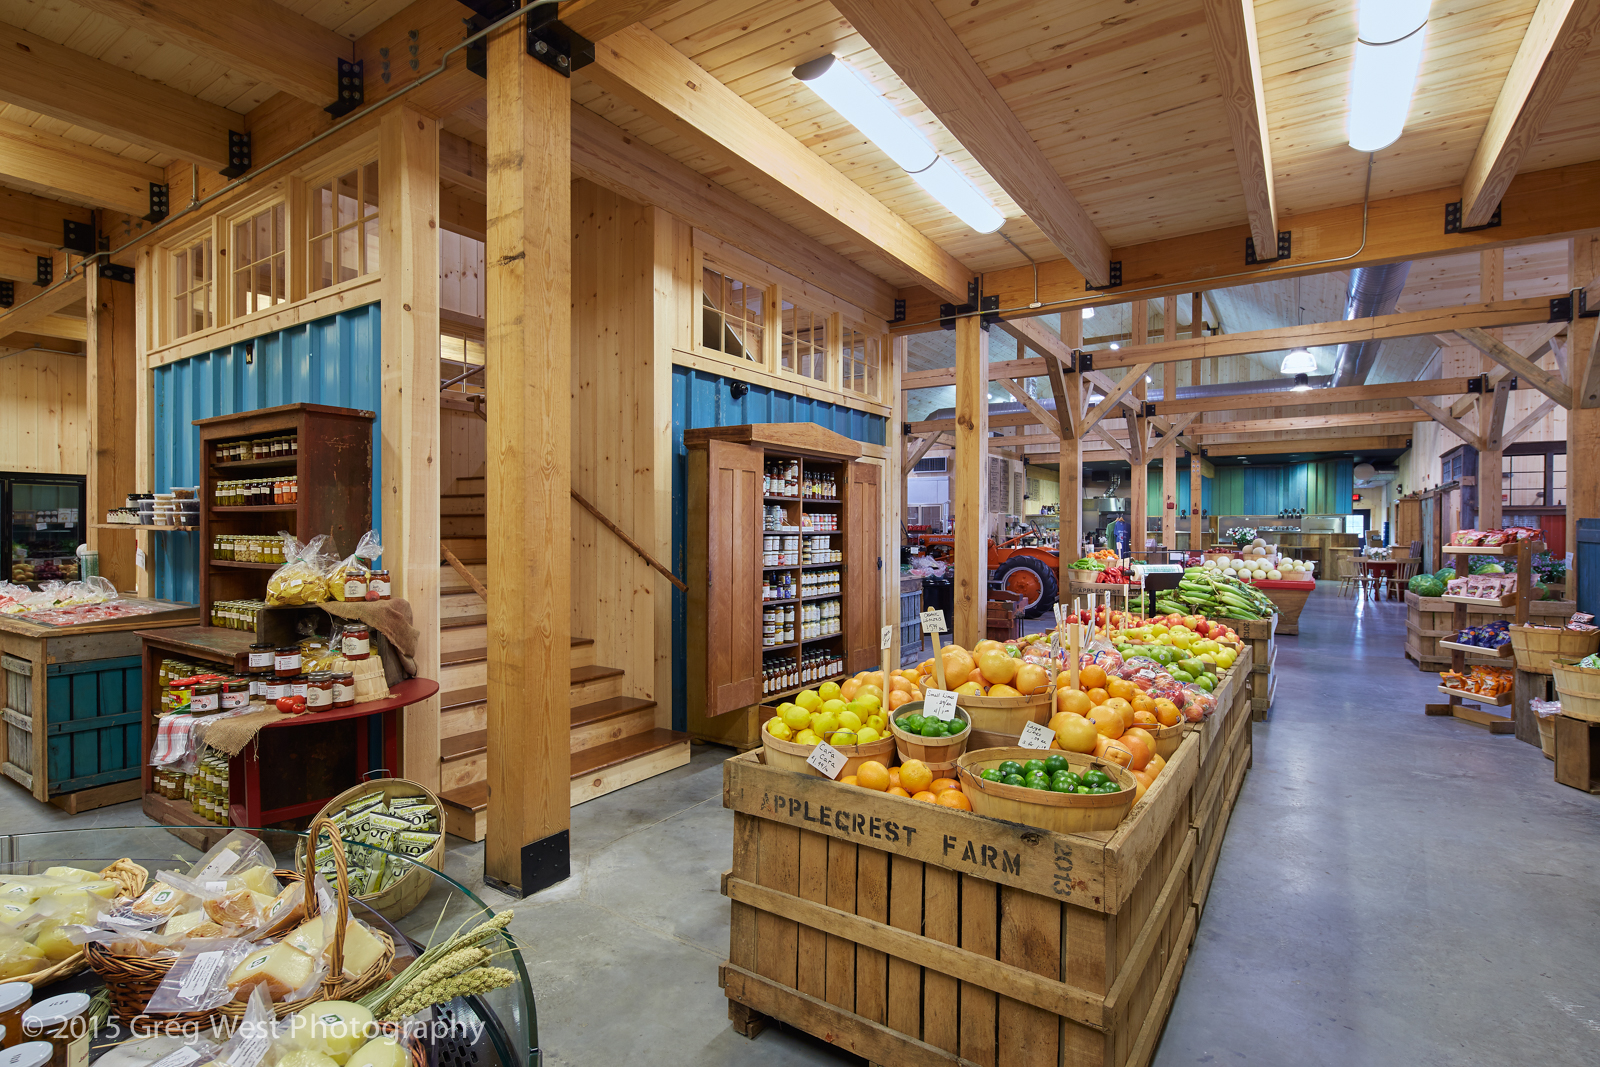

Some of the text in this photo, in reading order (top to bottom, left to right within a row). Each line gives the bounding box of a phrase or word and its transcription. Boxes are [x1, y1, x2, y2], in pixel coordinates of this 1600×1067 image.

[819, 743, 835, 759] Cara
[819, 753, 836, 769] Cara
[760, 792, 1022, 877] APPLECREST FARM
[1053, 841, 1073, 897] 2013
